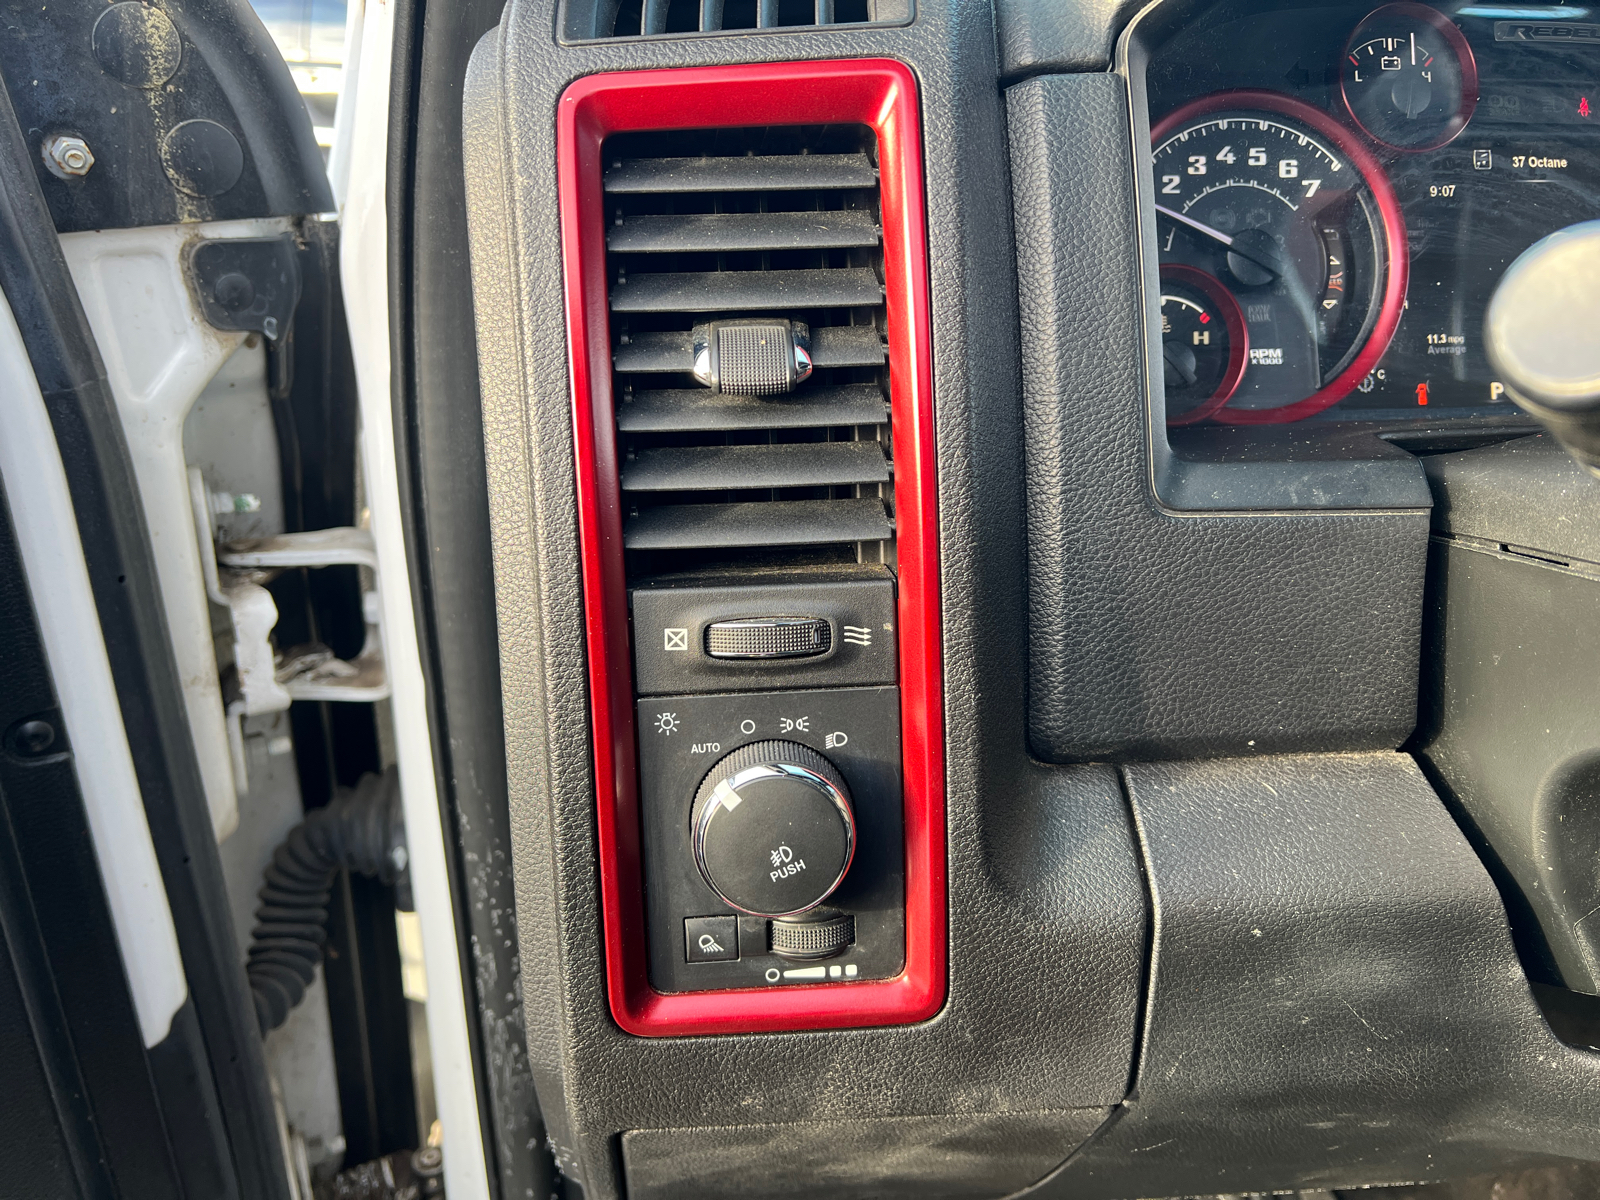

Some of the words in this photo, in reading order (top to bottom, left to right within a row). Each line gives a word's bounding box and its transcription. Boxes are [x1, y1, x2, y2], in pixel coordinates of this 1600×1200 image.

[1504, 24, 1600, 40] REBEL
[1512, 156, 1525, 168] 37
[1528, 156, 1568, 168] Octane
[1162, 175, 1181, 194] 2
[1187, 155, 1207, 175] 3
[1216, 146, 1236, 164] 4
[1248, 147, 1267, 166] 5
[1278, 159, 1298, 178] 6
[1301, 179, 1322, 198] 7
[1429, 185, 1456, 197] 9:07
[1193, 331, 1210, 345] H
[1426, 334, 1447, 344] 11.3
[1249, 348, 1282, 358] RPM
[1427, 345, 1467, 355] Average
[1490, 382, 1505, 400] P
[691, 743, 721, 754] AUTO
[769, 859, 806, 882] PUSH
